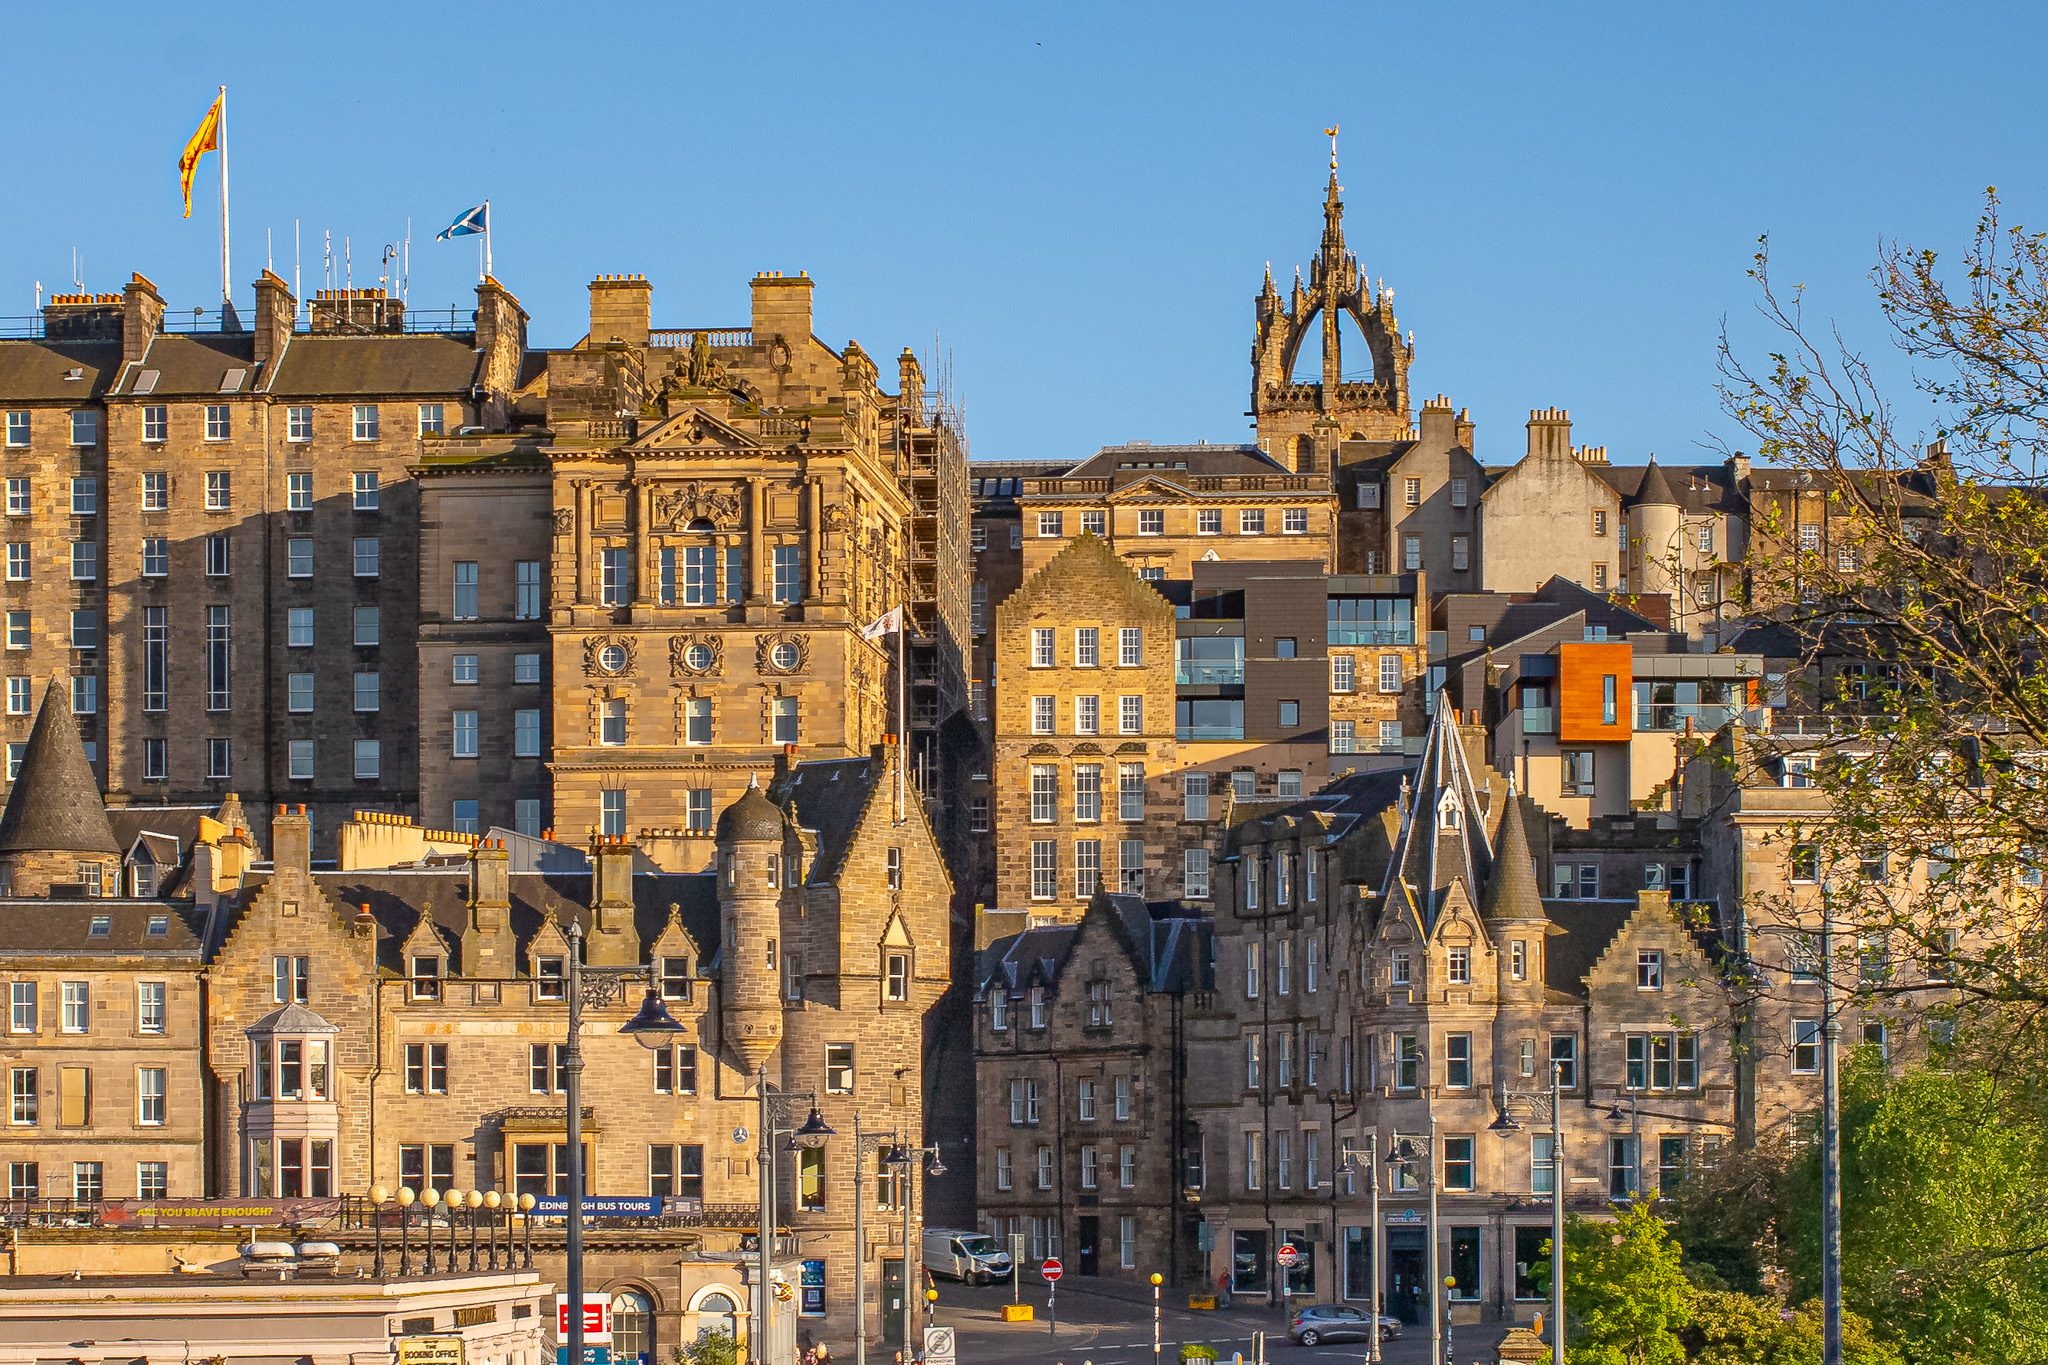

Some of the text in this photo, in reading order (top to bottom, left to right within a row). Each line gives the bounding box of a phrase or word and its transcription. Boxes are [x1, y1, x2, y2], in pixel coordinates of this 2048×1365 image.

[481, 1023, 594, 1034] COCKBUN
[539, 1202, 650, 1211] EDINBGH BUS TOURS
[137, 1207, 273, 1217] ARE YOU BRAVE ENOUGH?
[404, 1350, 458, 1359] BOOKING OFFICE
